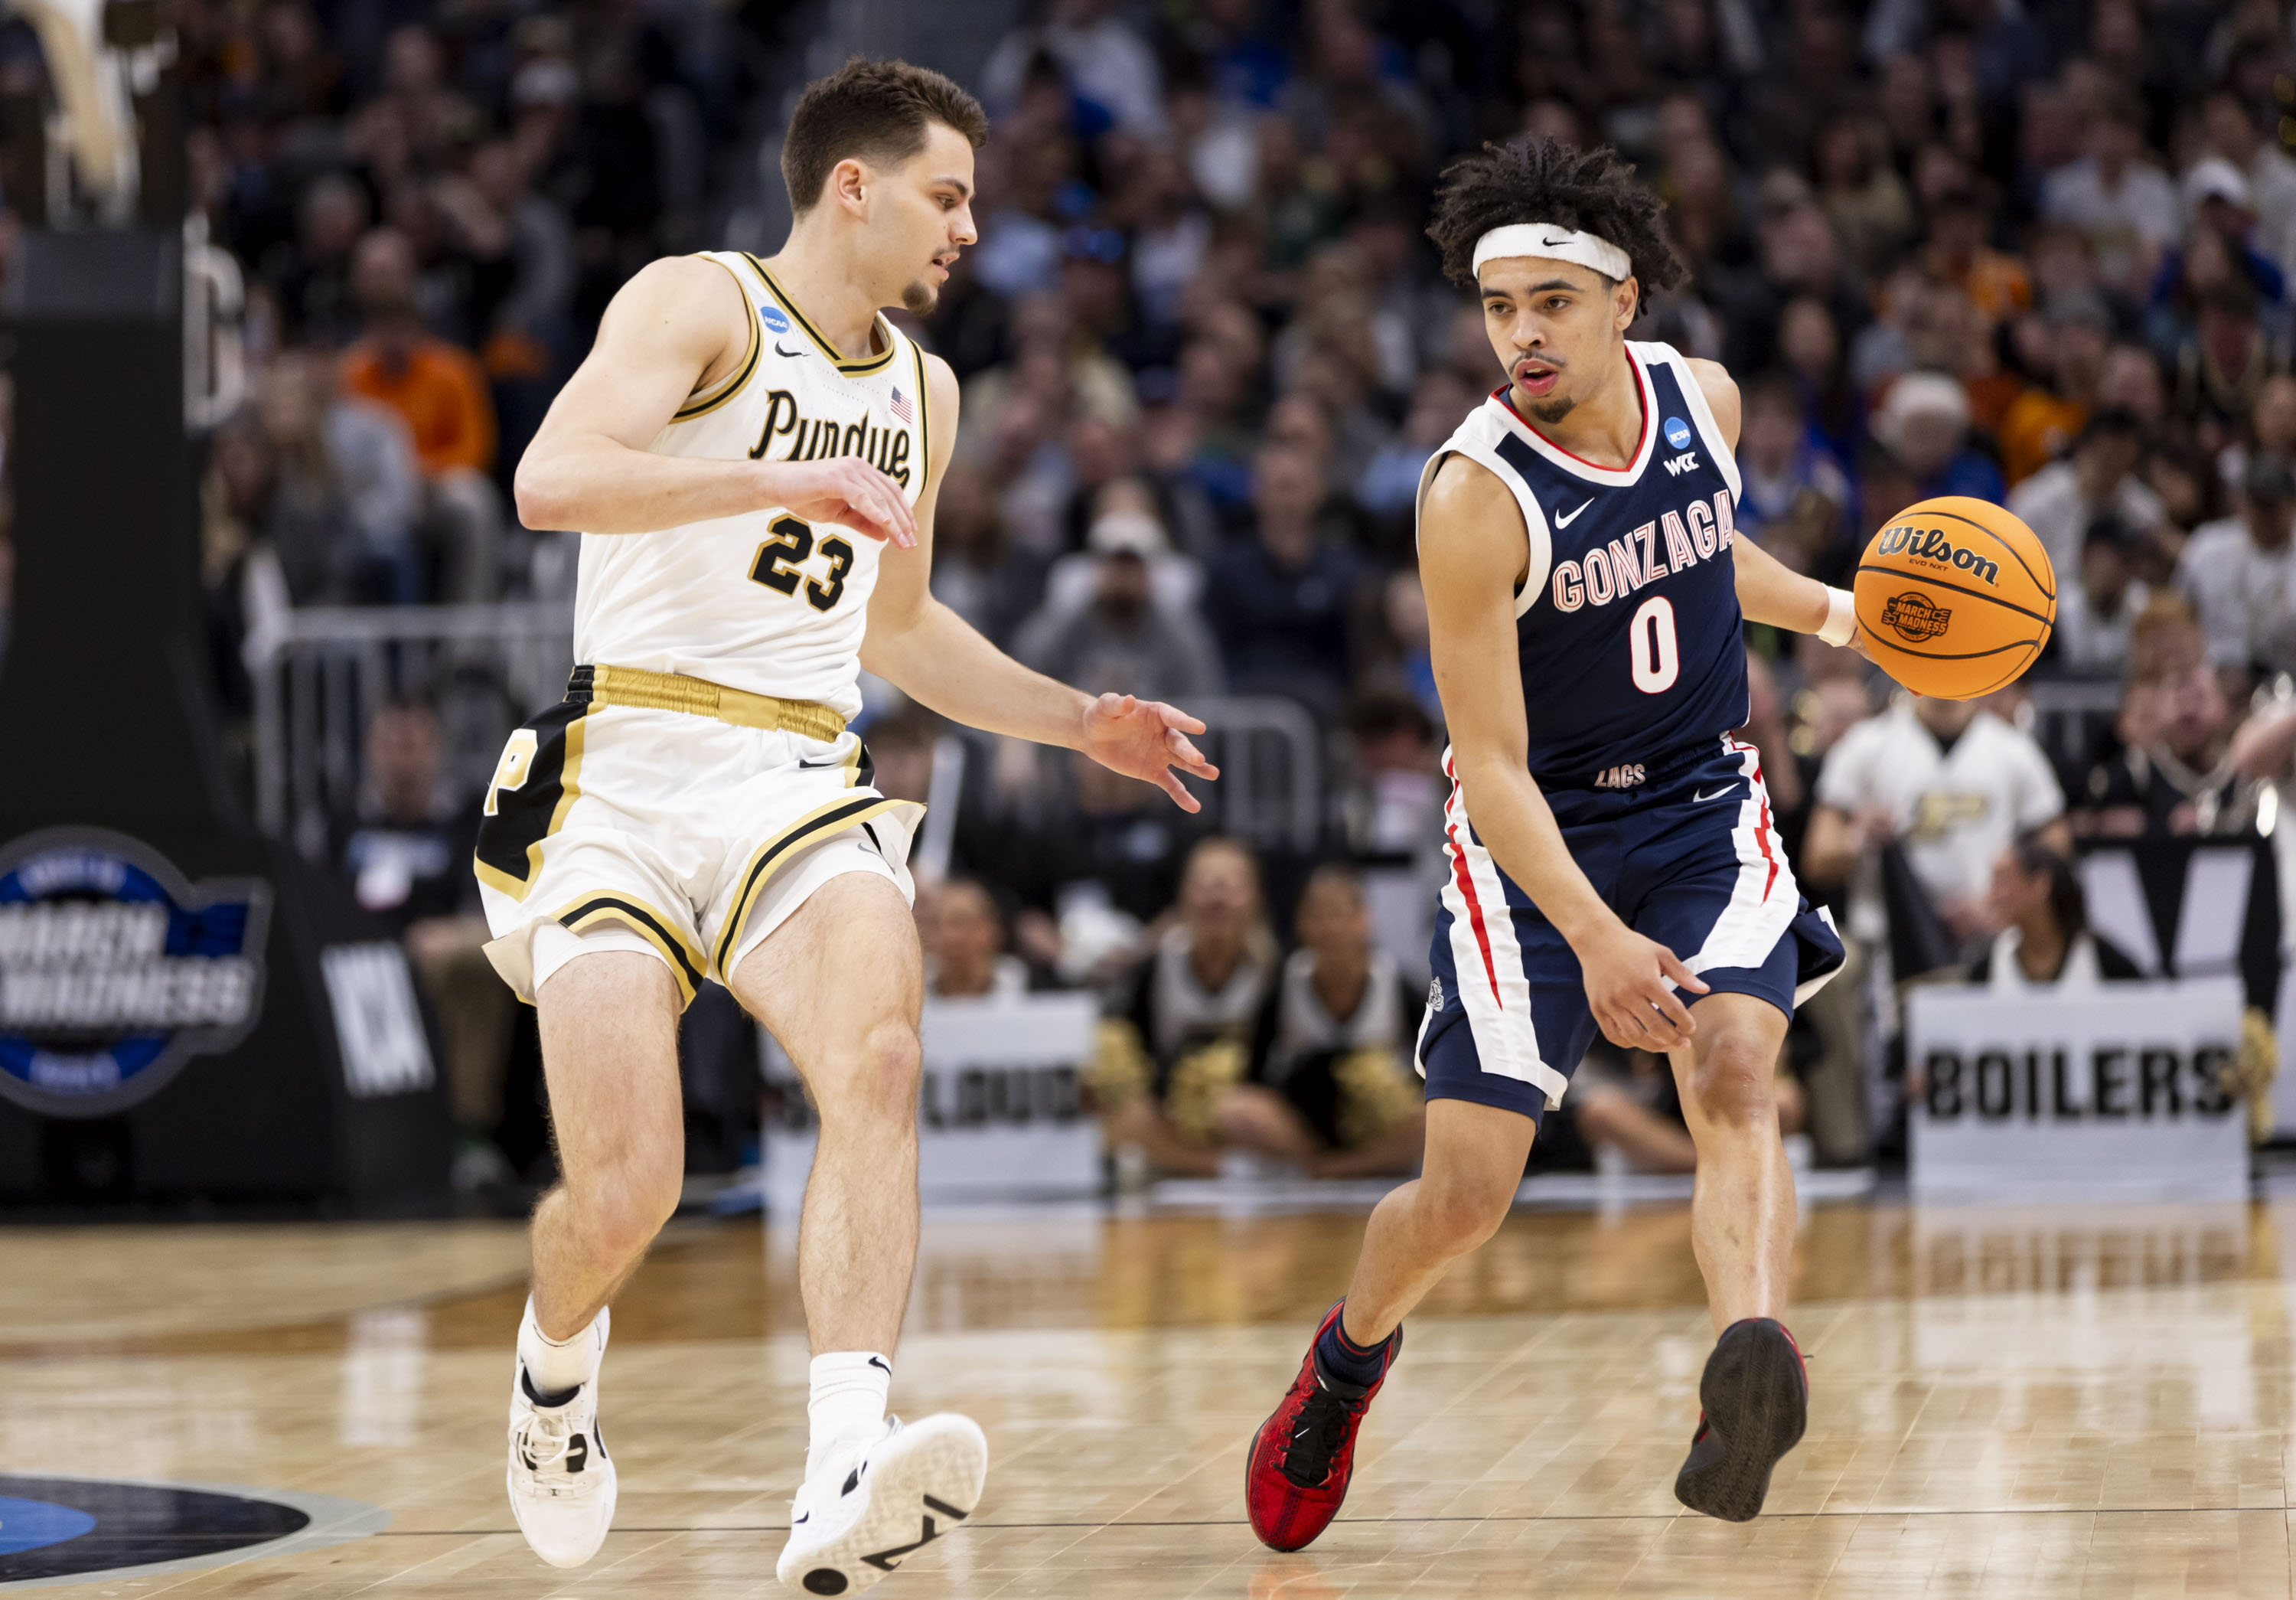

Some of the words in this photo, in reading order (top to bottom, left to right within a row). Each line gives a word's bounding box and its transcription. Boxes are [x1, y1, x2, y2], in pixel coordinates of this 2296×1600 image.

[765, 316, 788, 329] NCAA
[747, 388, 910, 491] Purdue
[1669, 429, 1690, 443] NCAA
[1663, 452, 1700, 477] WCC
[747, 513, 853, 613] 23
[1552, 488, 1733, 612] GONZAGA
[1877, 526, 1999, 586] Wilson
[1909, 558, 1927, 567] EVO
[1929, 563, 1949, 572] NXT
[1898, 602, 1932, 619] MARCH
[1899, 613, 1947, 633] MADNESS
[1630, 596, 1679, 694] 0
[1926, 1046, 2233, 1120] BOILERS
